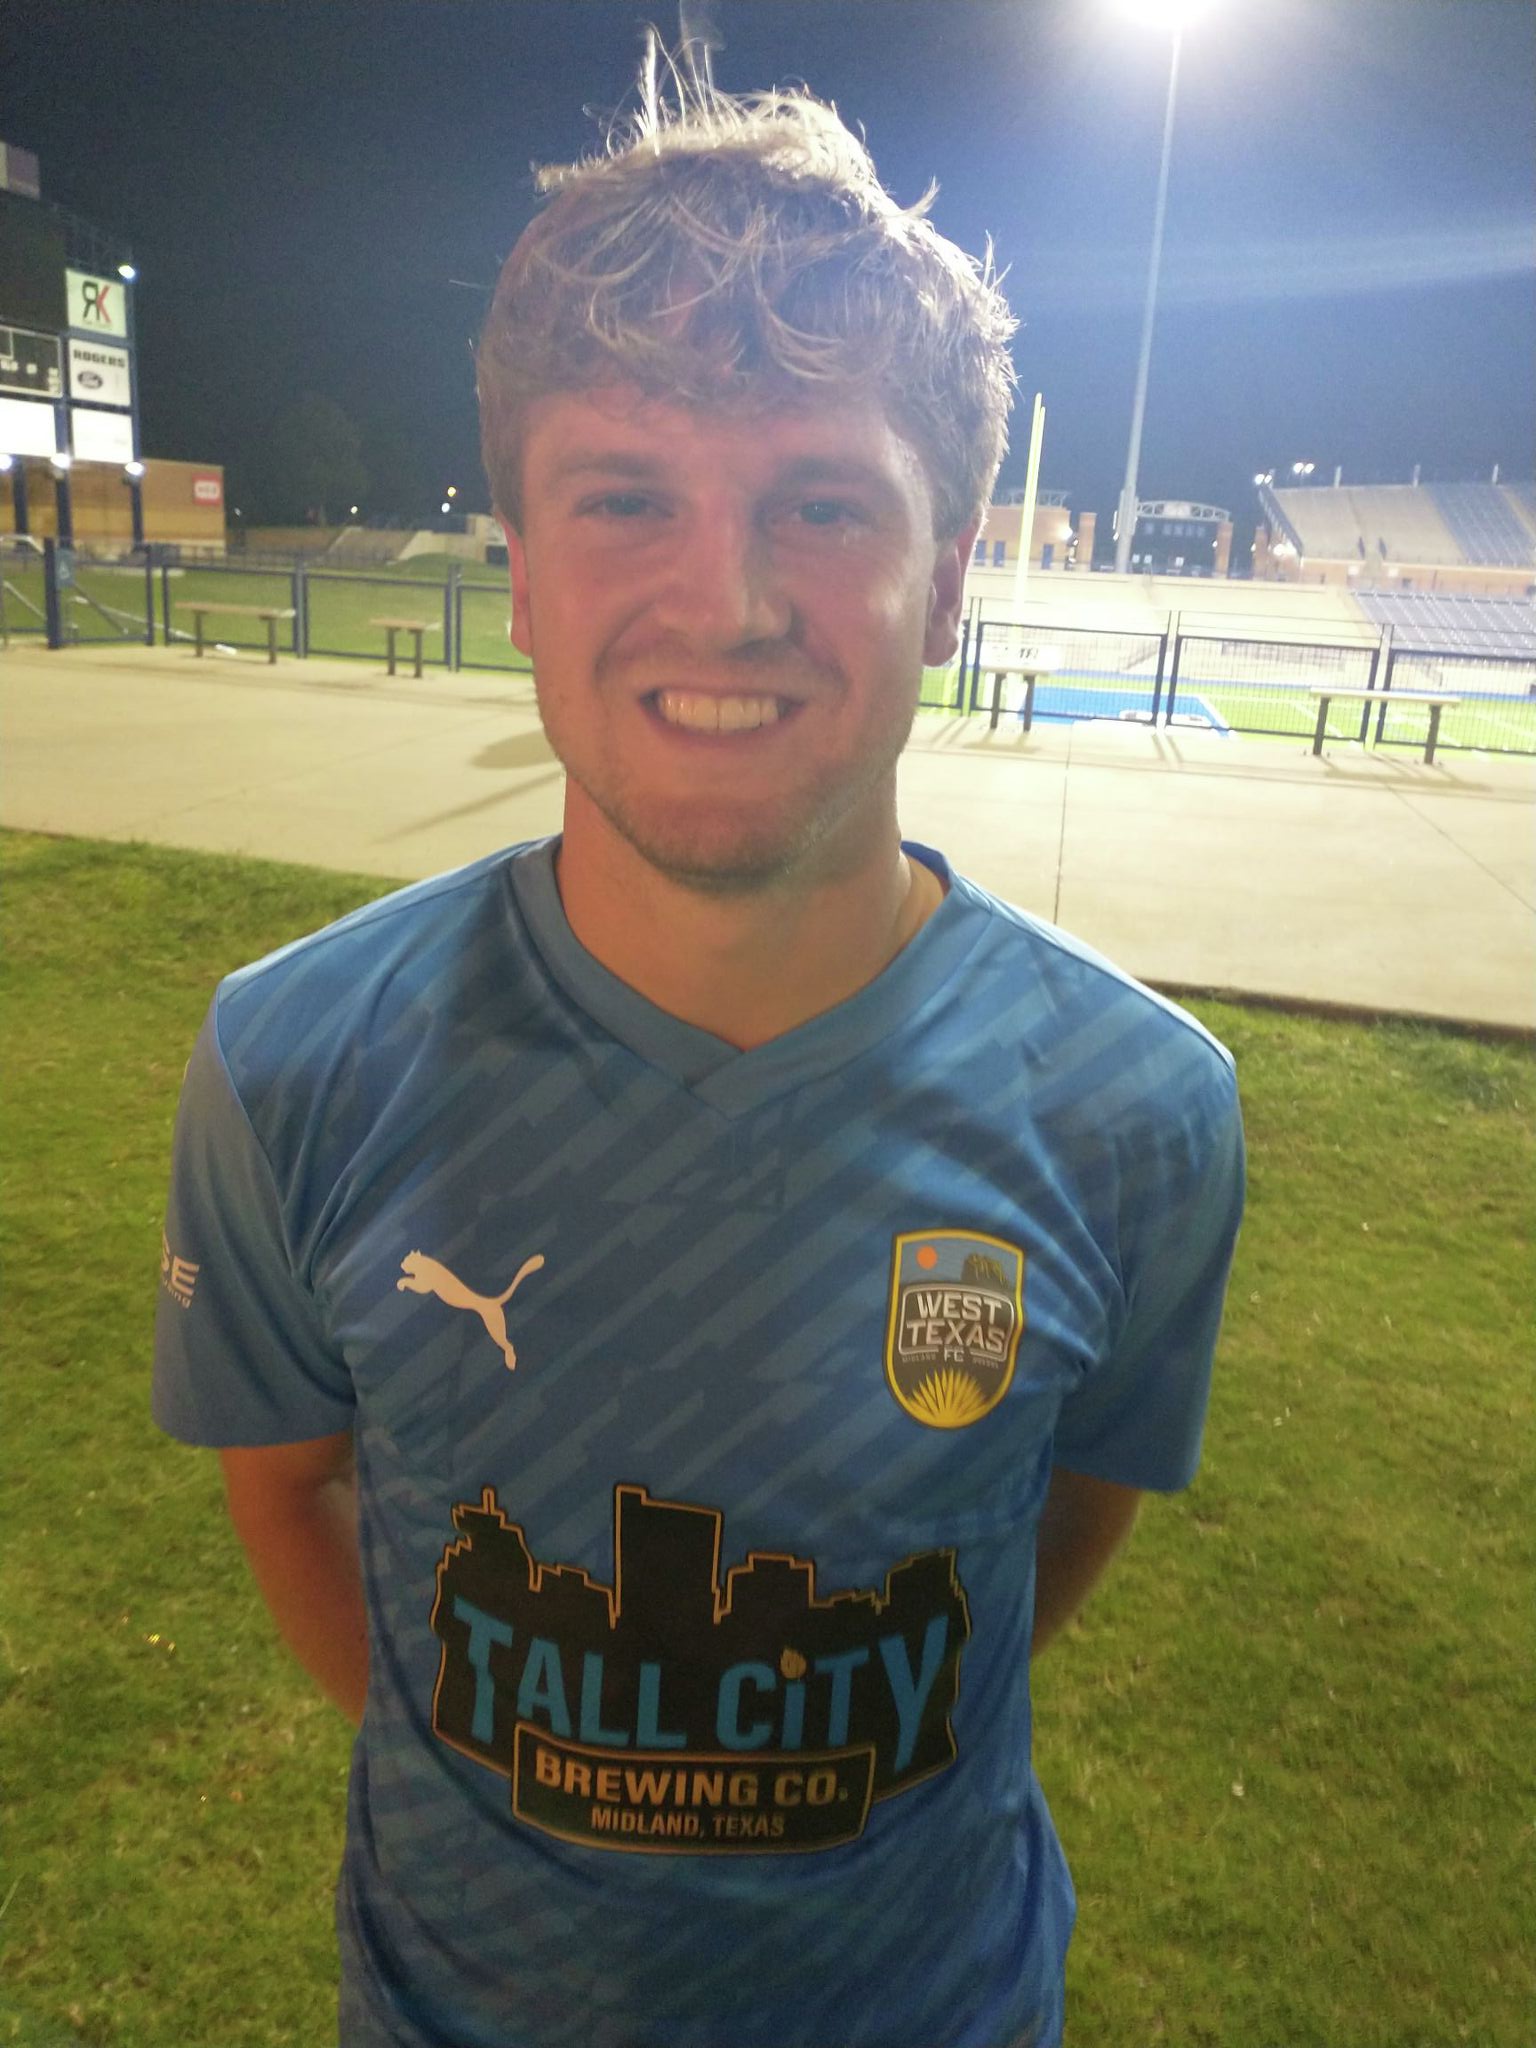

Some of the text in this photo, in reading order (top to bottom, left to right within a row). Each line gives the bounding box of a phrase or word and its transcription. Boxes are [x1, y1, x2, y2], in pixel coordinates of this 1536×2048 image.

[917, 1291, 1002, 1325] WEST
[907, 1319, 1005, 1350] TEXAS
[943, 1348, 964, 1362] FC
[453, 1594, 688, 1746] TALL
[535, 1747, 760, 1805] BREWING
[591, 1806, 785, 1838] MIDLAND, TEXAS
